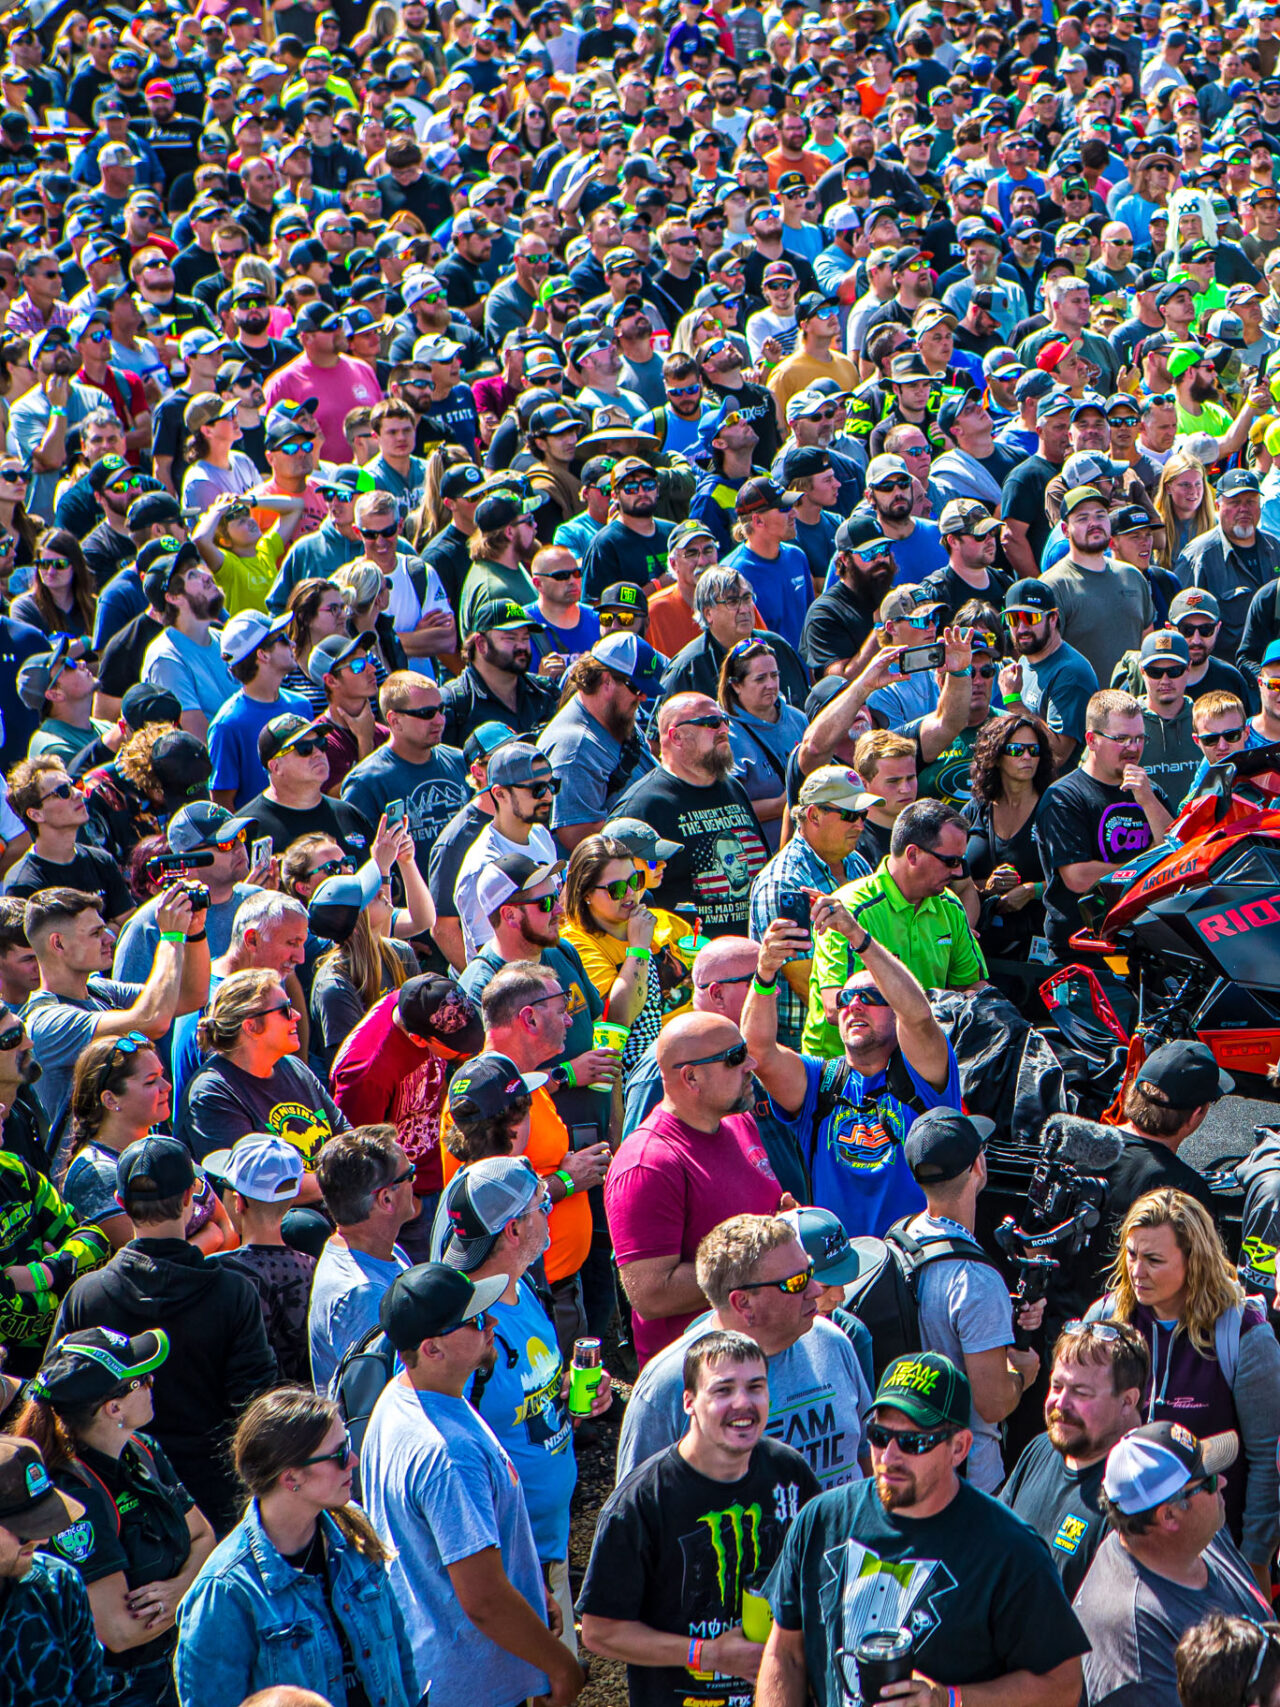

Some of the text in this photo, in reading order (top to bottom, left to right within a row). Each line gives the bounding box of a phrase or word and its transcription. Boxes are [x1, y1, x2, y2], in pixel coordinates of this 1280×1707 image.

[1144, 760, 1200, 774] arhartt
[678, 822, 704, 837] THE
[1142, 859, 1199, 892] ARCTIC CAT
[694, 905, 713, 916] HIS
[715, 902, 734, 913] MAD
[705, 914, 728, 924] AWAY
[1031, 1235, 1057, 1248] RONIN
[893, 1361, 940, 1383] TEAM
[884, 1371, 937, 1396] ARCTIC
[764, 1402, 837, 1446] EAM
[804, 1431, 846, 1473] TIC
